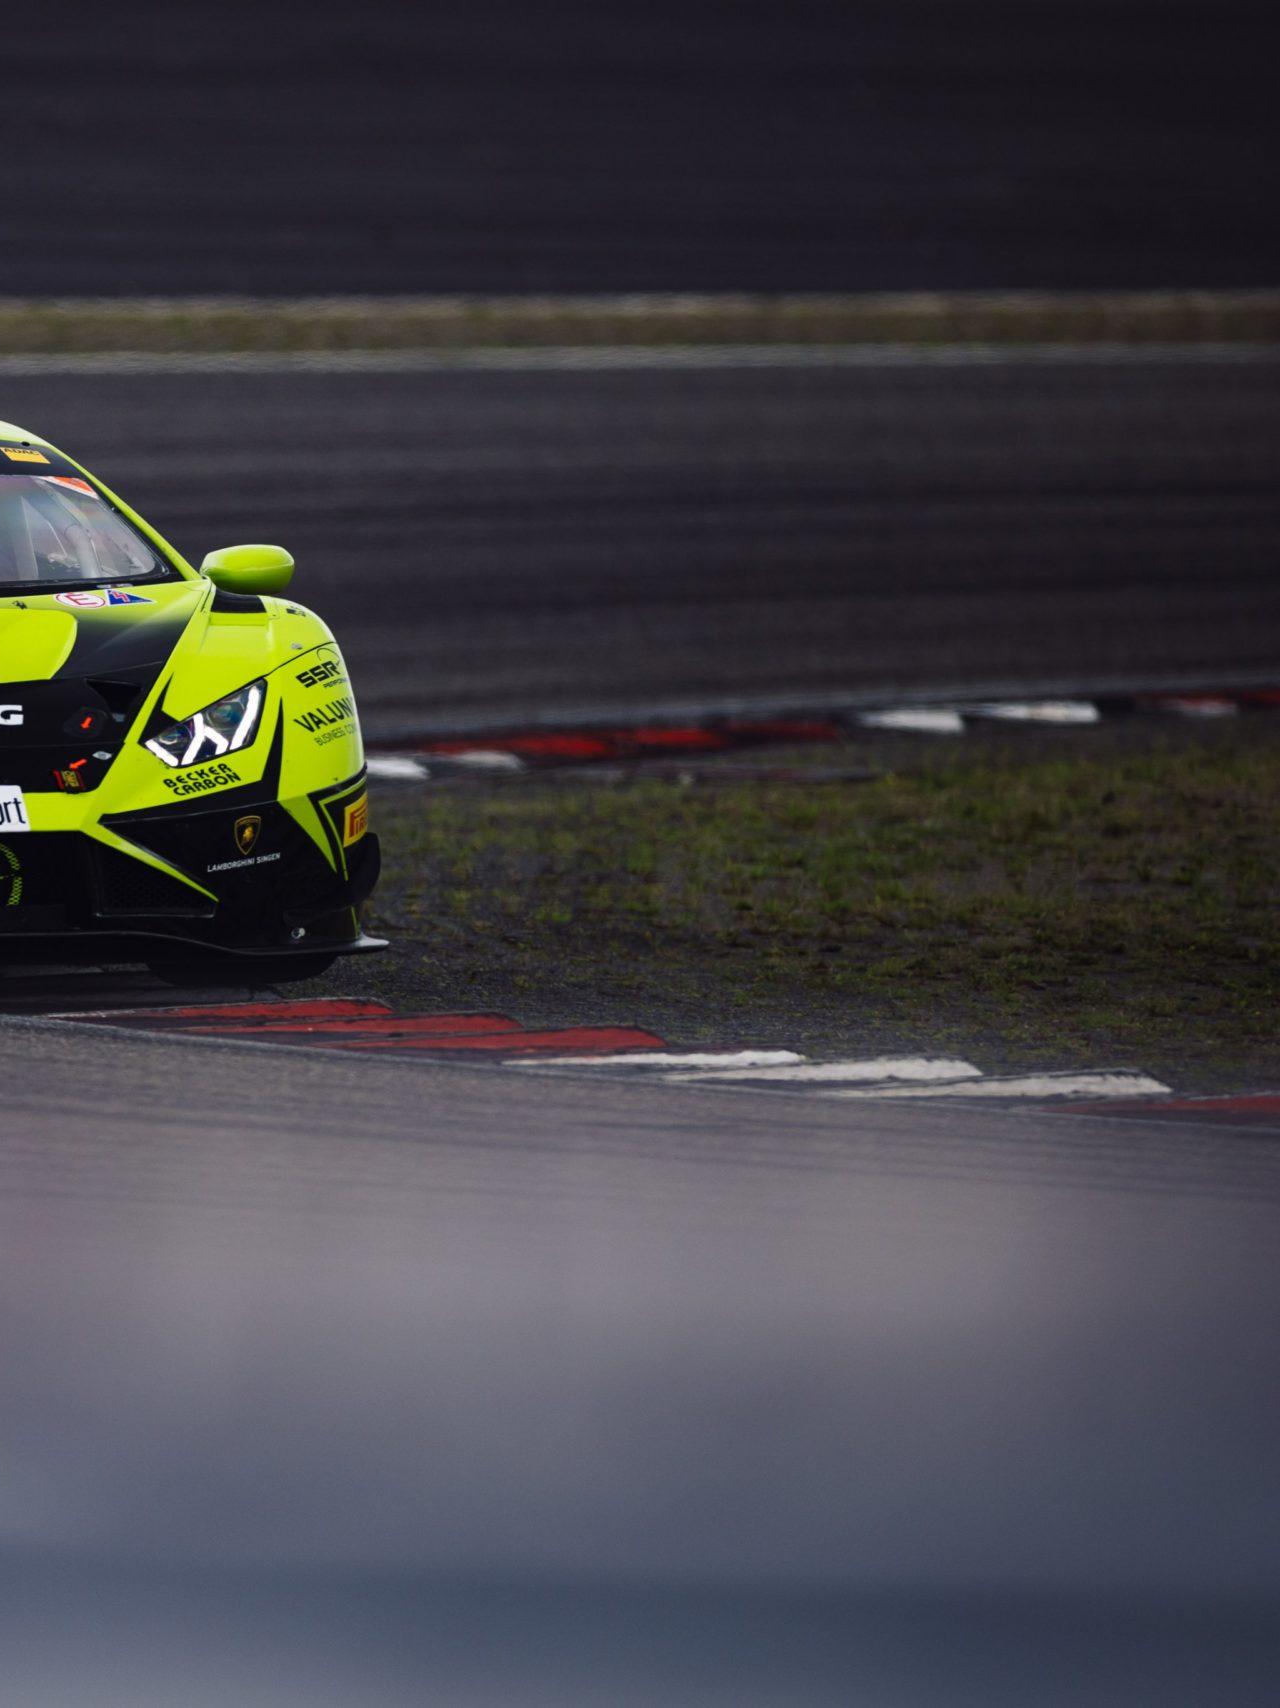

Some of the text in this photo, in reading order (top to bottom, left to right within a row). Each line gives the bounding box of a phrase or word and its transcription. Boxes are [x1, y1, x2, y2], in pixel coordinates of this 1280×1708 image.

[296, 660, 341, 688] SSR
[163, 763, 232, 788] BECKER
[173, 772, 241, 796] CARBON
[207, 851, 281, 873] LAMBORGHINI SINGEN
